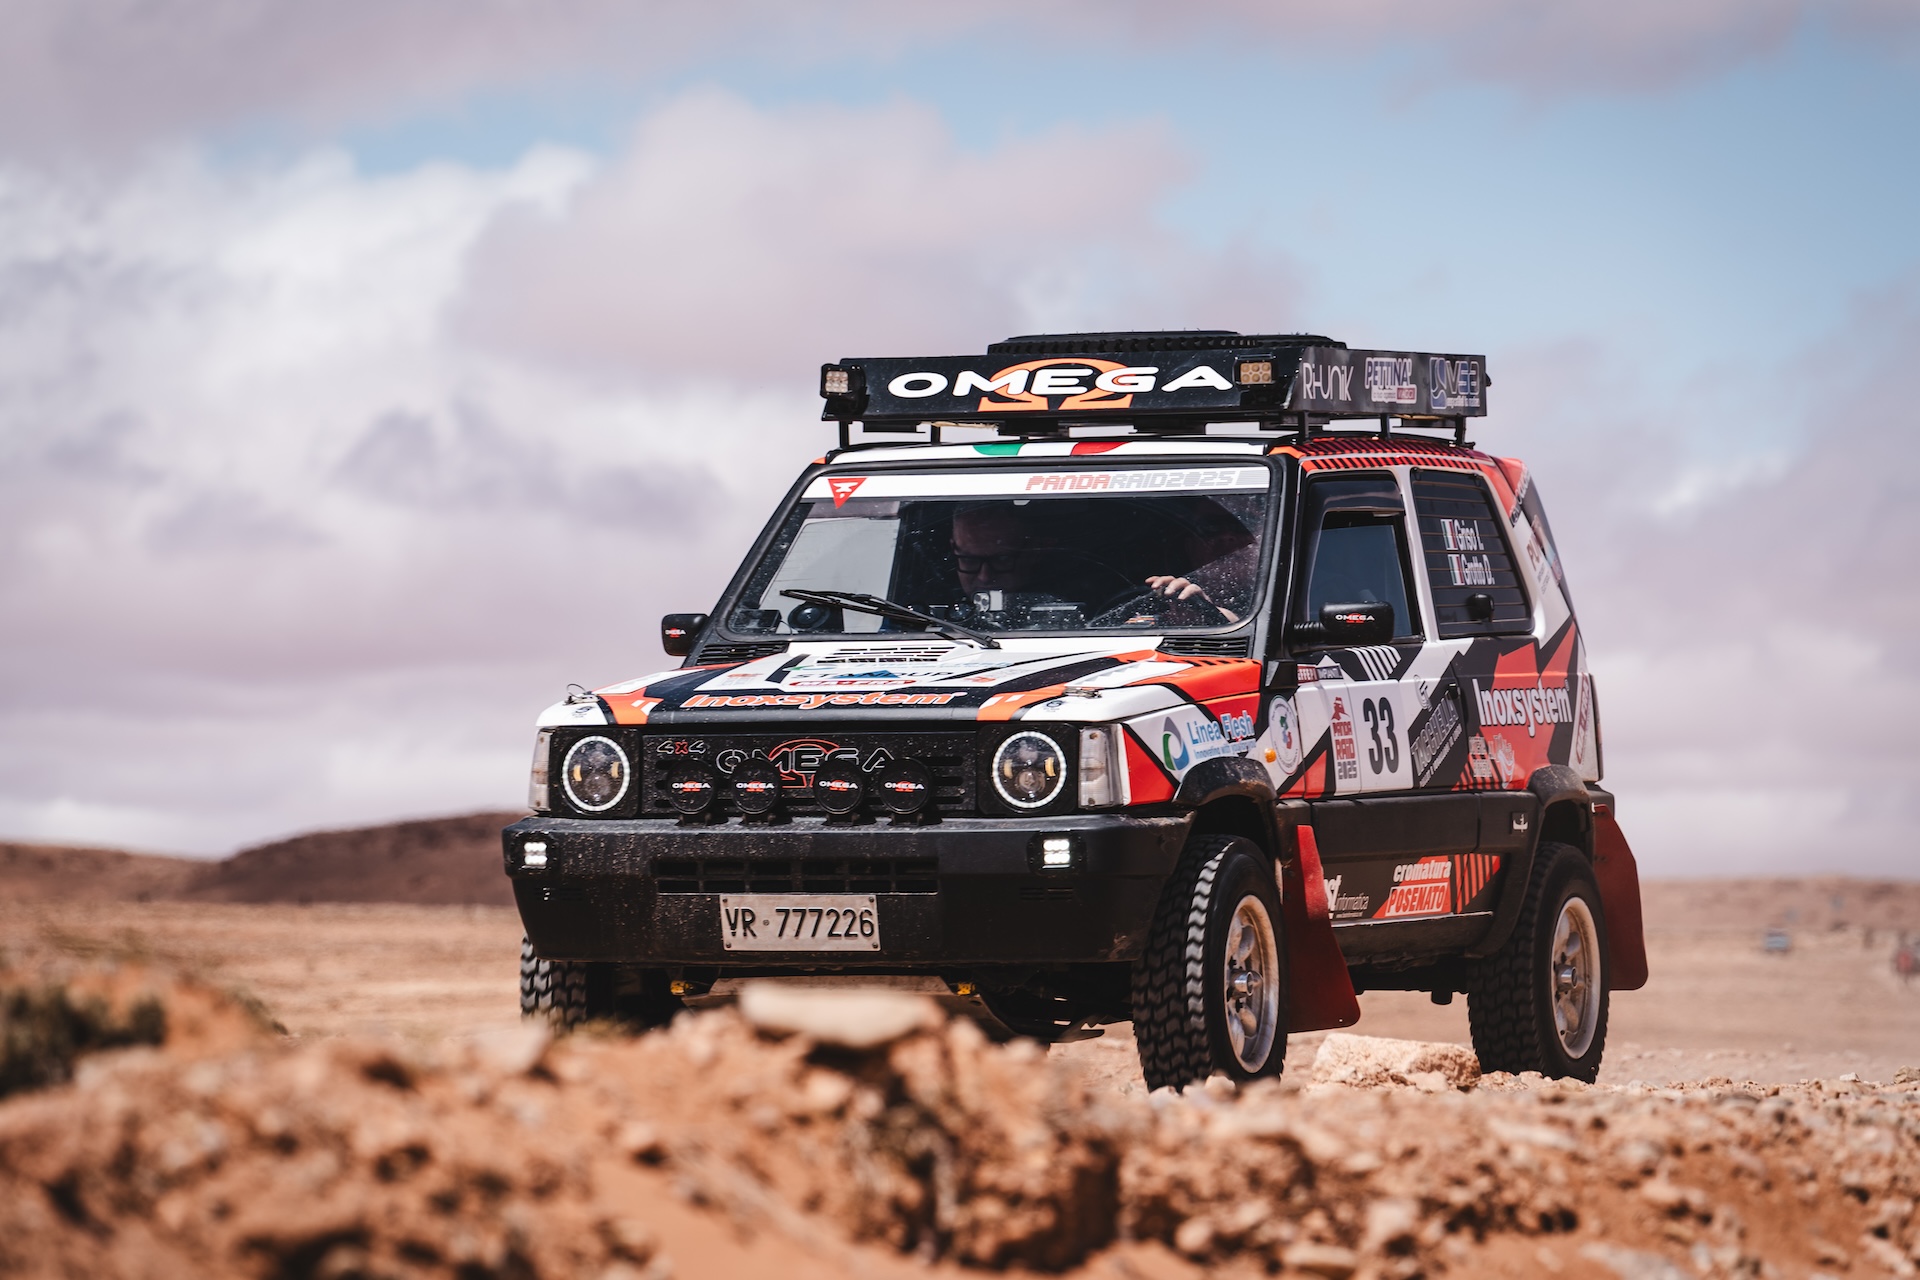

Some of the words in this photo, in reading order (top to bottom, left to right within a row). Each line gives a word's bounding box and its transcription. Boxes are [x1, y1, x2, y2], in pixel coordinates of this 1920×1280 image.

[887, 365, 1233, 398] OMEGA
[680, 692, 954, 709] Inoxsystem
[1472, 678, 1573, 738] Inoxsystem
[1187, 720, 1221, 745] Linea
[1220, 709, 1255, 740] Flesh
[1362, 697, 1399, 775] 33
[1335, 738, 1355, 760] RAID
[1337, 761, 1357, 779] 2025
[819, 780, 858, 789] OMEGA
[884, 781, 925, 790] OMEGA
[1393, 860, 1452, 882] cromatura
[1387, 885, 1446, 913] POSENATO
[726, 908, 757, 937] VR
[775, 907, 875, 938] 777226
